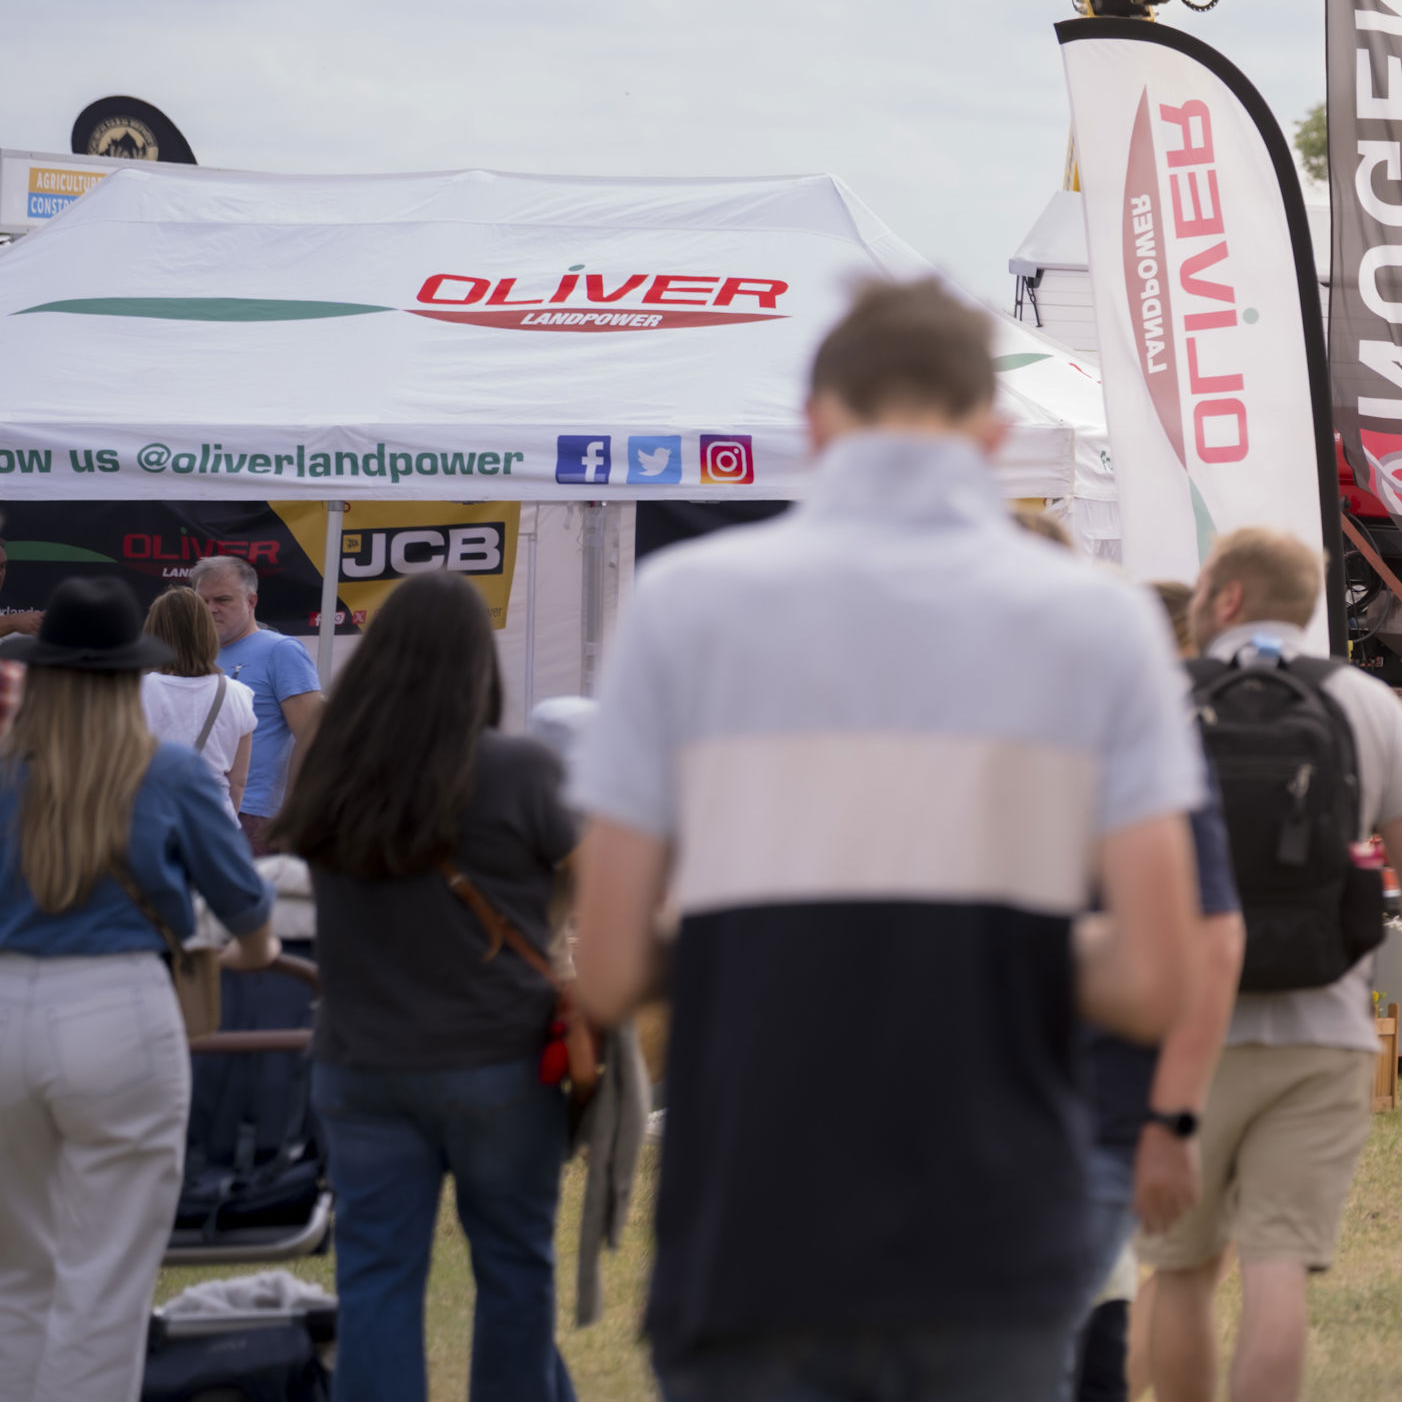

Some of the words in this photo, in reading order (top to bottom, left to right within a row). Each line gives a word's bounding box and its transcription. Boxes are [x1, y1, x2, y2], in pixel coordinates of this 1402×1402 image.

[415, 263, 789, 310] OLIVER
[519, 311, 664, 328] LANDPOWER
[69, 447, 120, 474] us
[136, 442, 525, 484] @oliverlandpower
[122, 526, 281, 564] OLIVER
[341, 526, 501, 579] JCB
